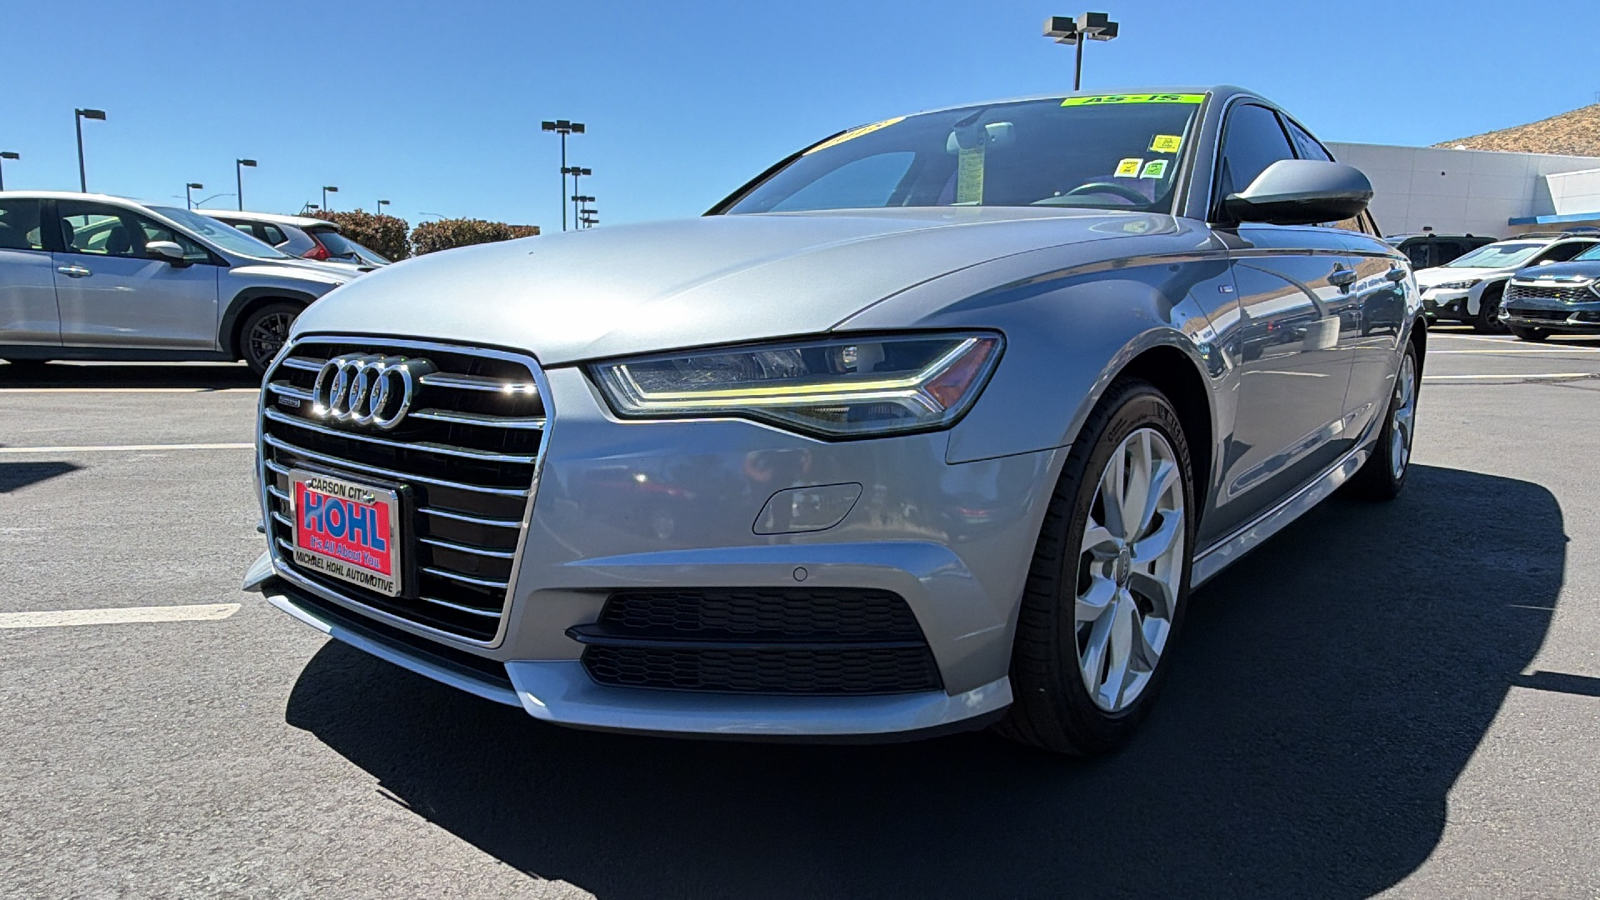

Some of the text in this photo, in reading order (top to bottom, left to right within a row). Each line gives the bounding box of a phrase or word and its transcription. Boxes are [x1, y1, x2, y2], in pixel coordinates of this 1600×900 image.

[311, 478, 368, 501] CARSON CITY
[304, 491, 386, 552] HOHL
[310, 535, 323, 549] It's
[324, 539, 336, 554] All
[337, 543, 361, 562] About
[296, 550, 394, 593] MICHAEL HOHL AUTOMOTIVE
